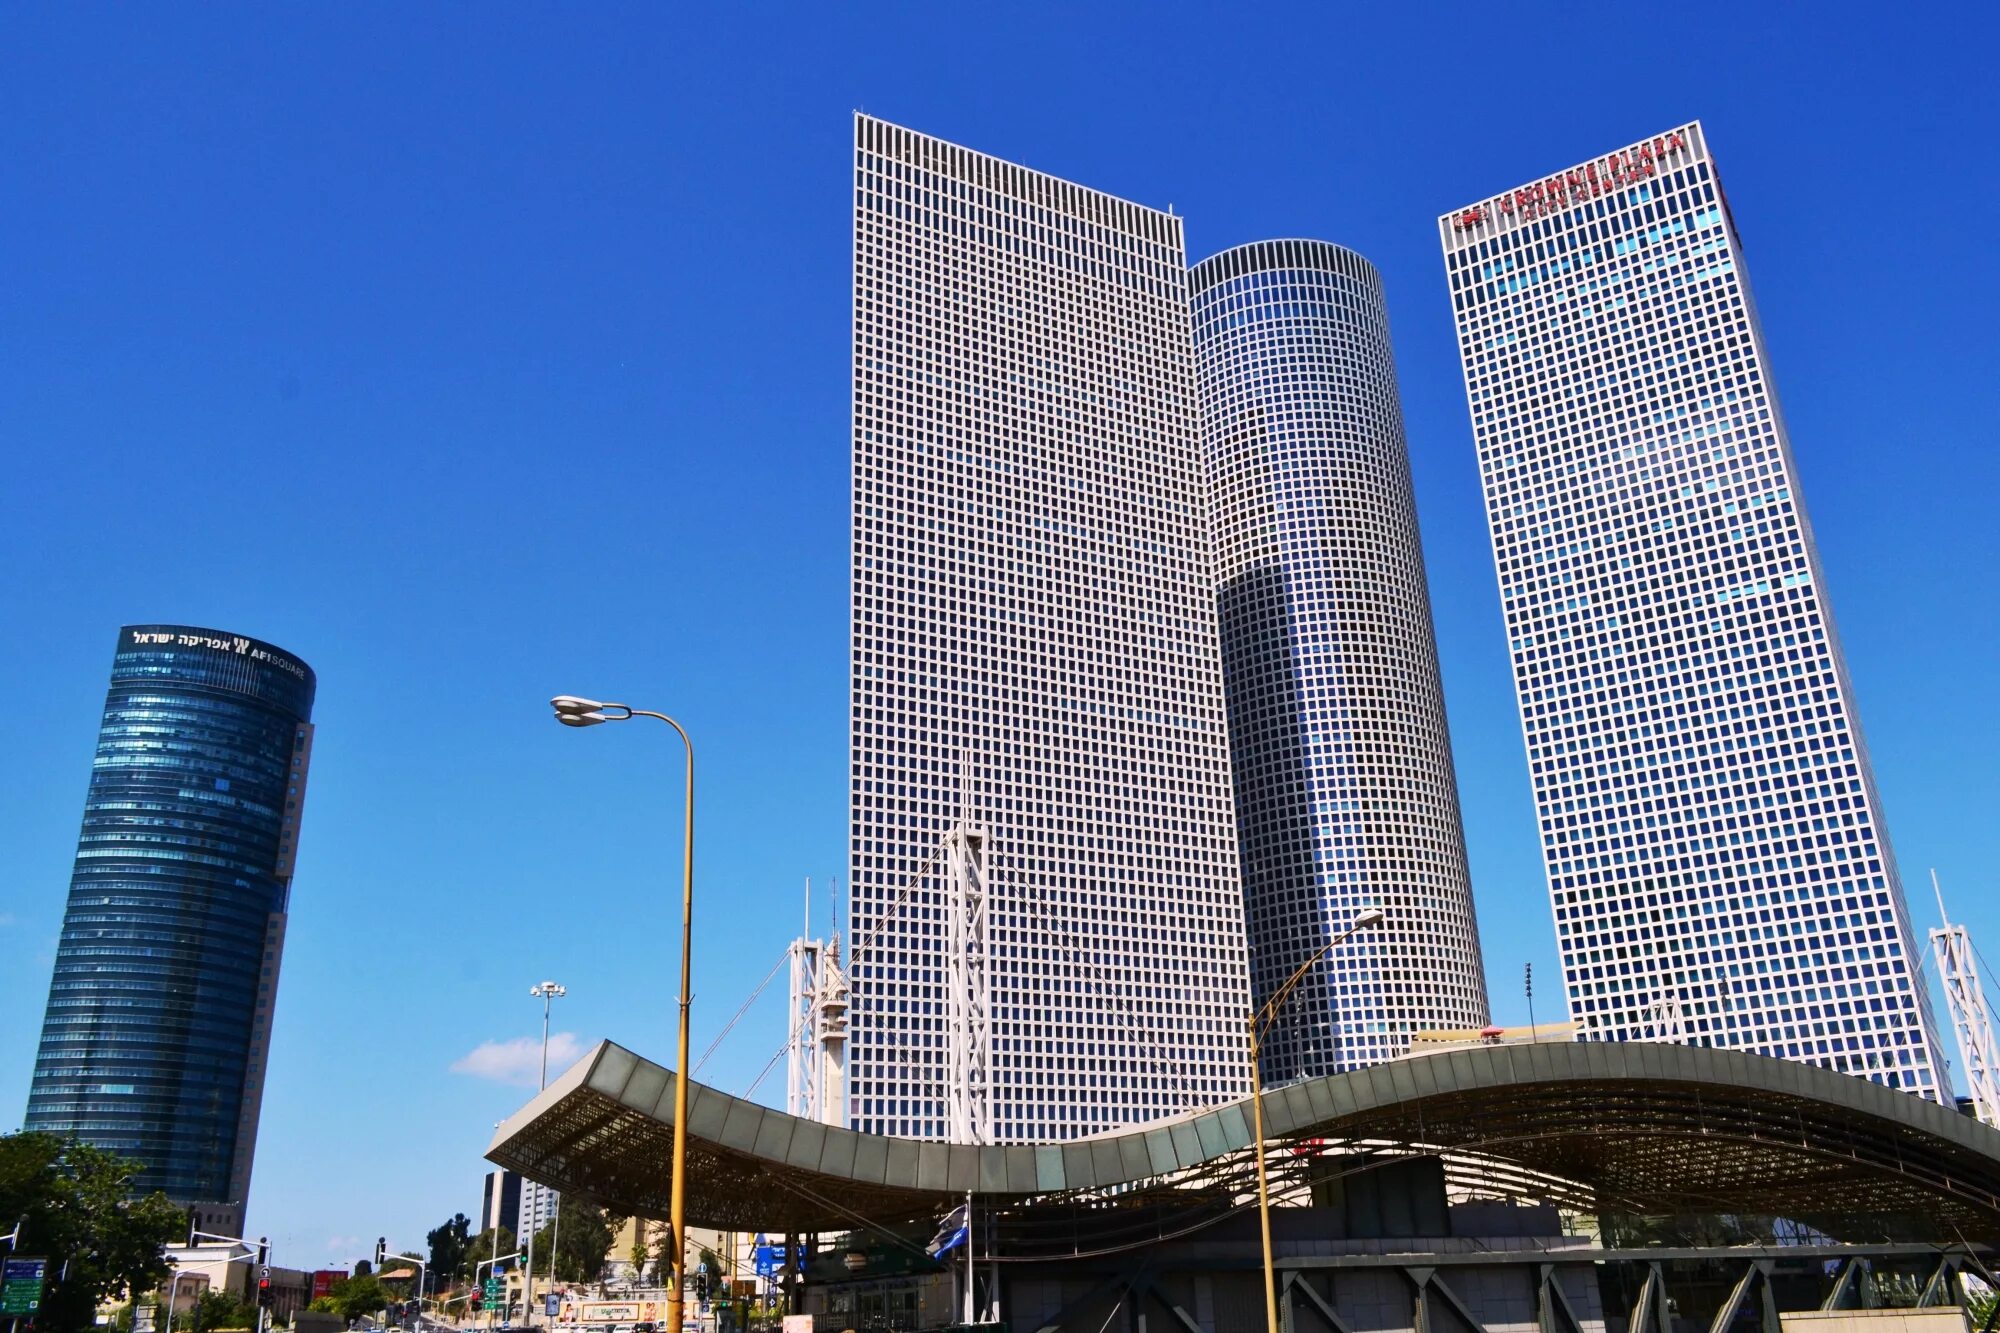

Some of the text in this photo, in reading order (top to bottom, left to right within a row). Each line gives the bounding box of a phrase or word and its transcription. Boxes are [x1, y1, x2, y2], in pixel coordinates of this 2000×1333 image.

[1500, 134, 1684, 213] CROWNE PLAZA
[133, 631, 230, 651] אפריקה ישראל
